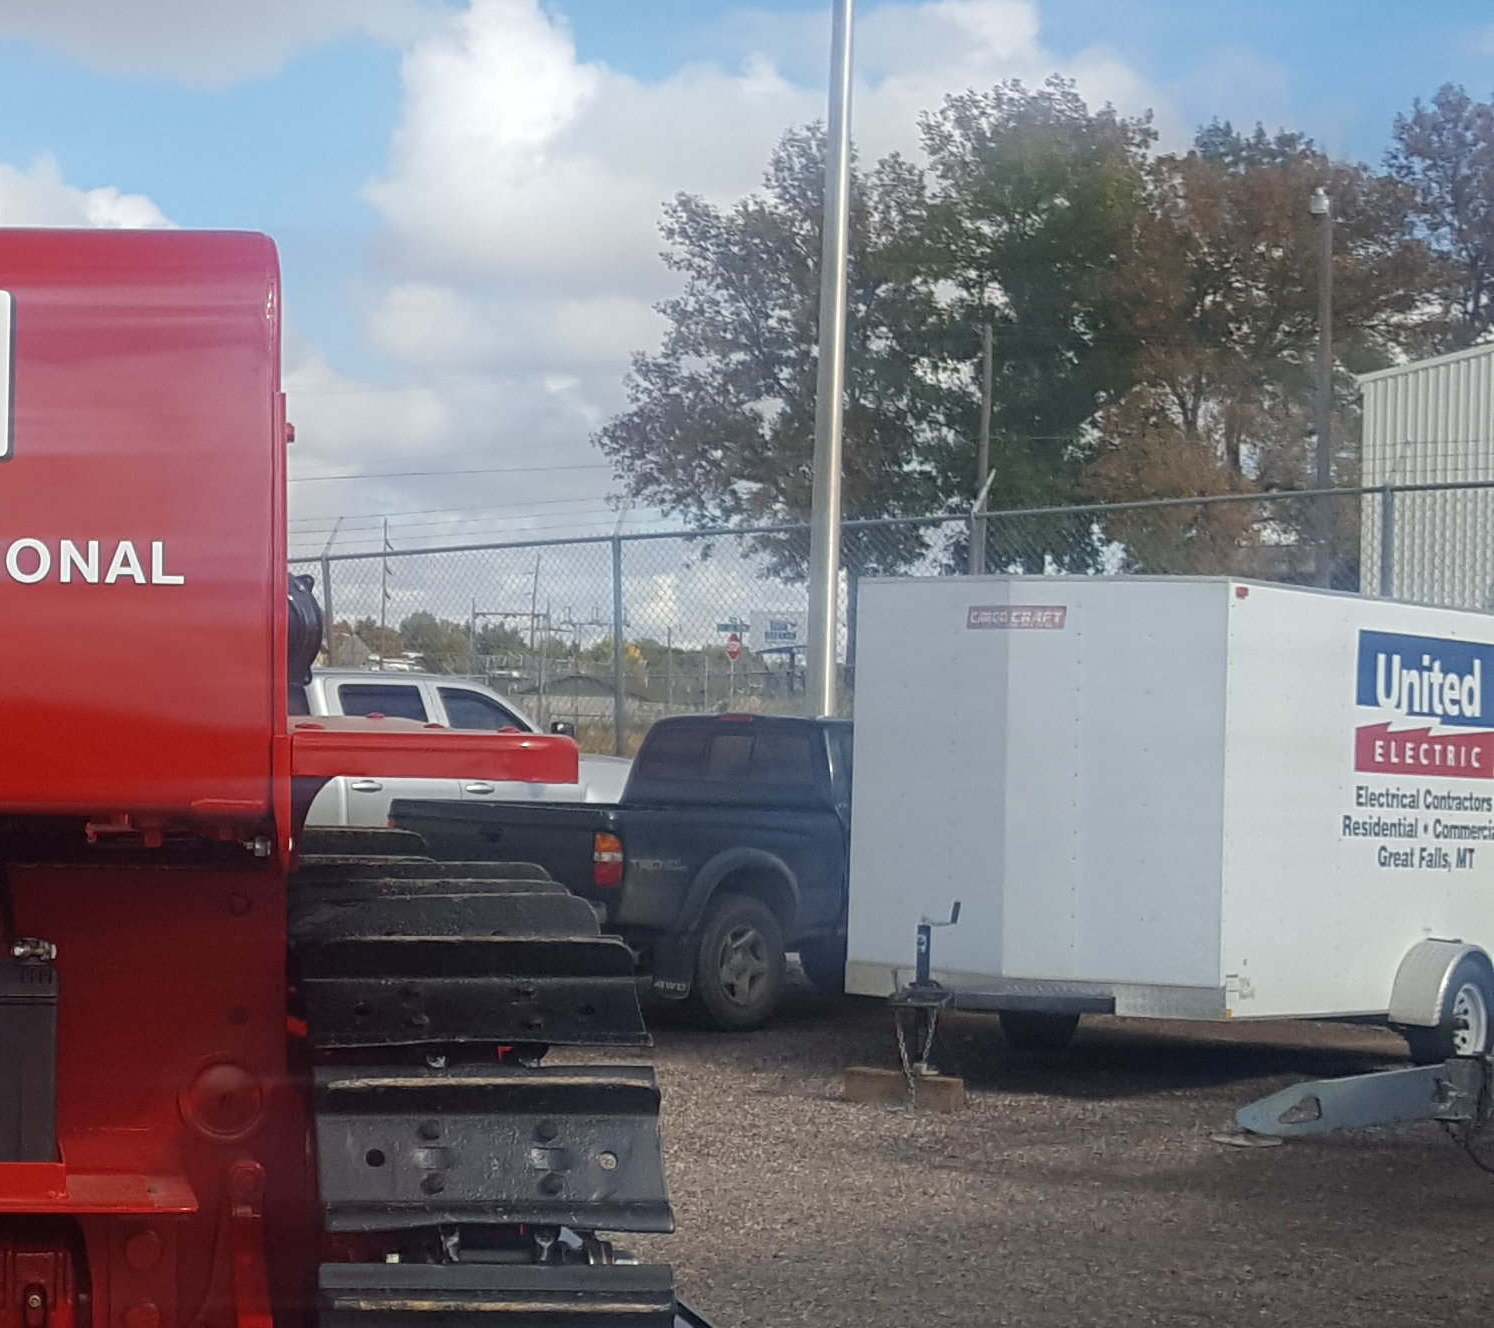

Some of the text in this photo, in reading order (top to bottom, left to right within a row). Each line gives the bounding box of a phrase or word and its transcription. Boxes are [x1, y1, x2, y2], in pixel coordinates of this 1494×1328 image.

[1376, 652, 1482, 718] United
[1374, 739, 1482, 768] ELECTRIC
[1356, 785, 1493, 812] Electrical Contractors
[1342, 814, 1494, 840] Residential Commerci
[1377, 845, 1475, 873] Great Falls, MT
[654, 980, 686, 992] 4WD
